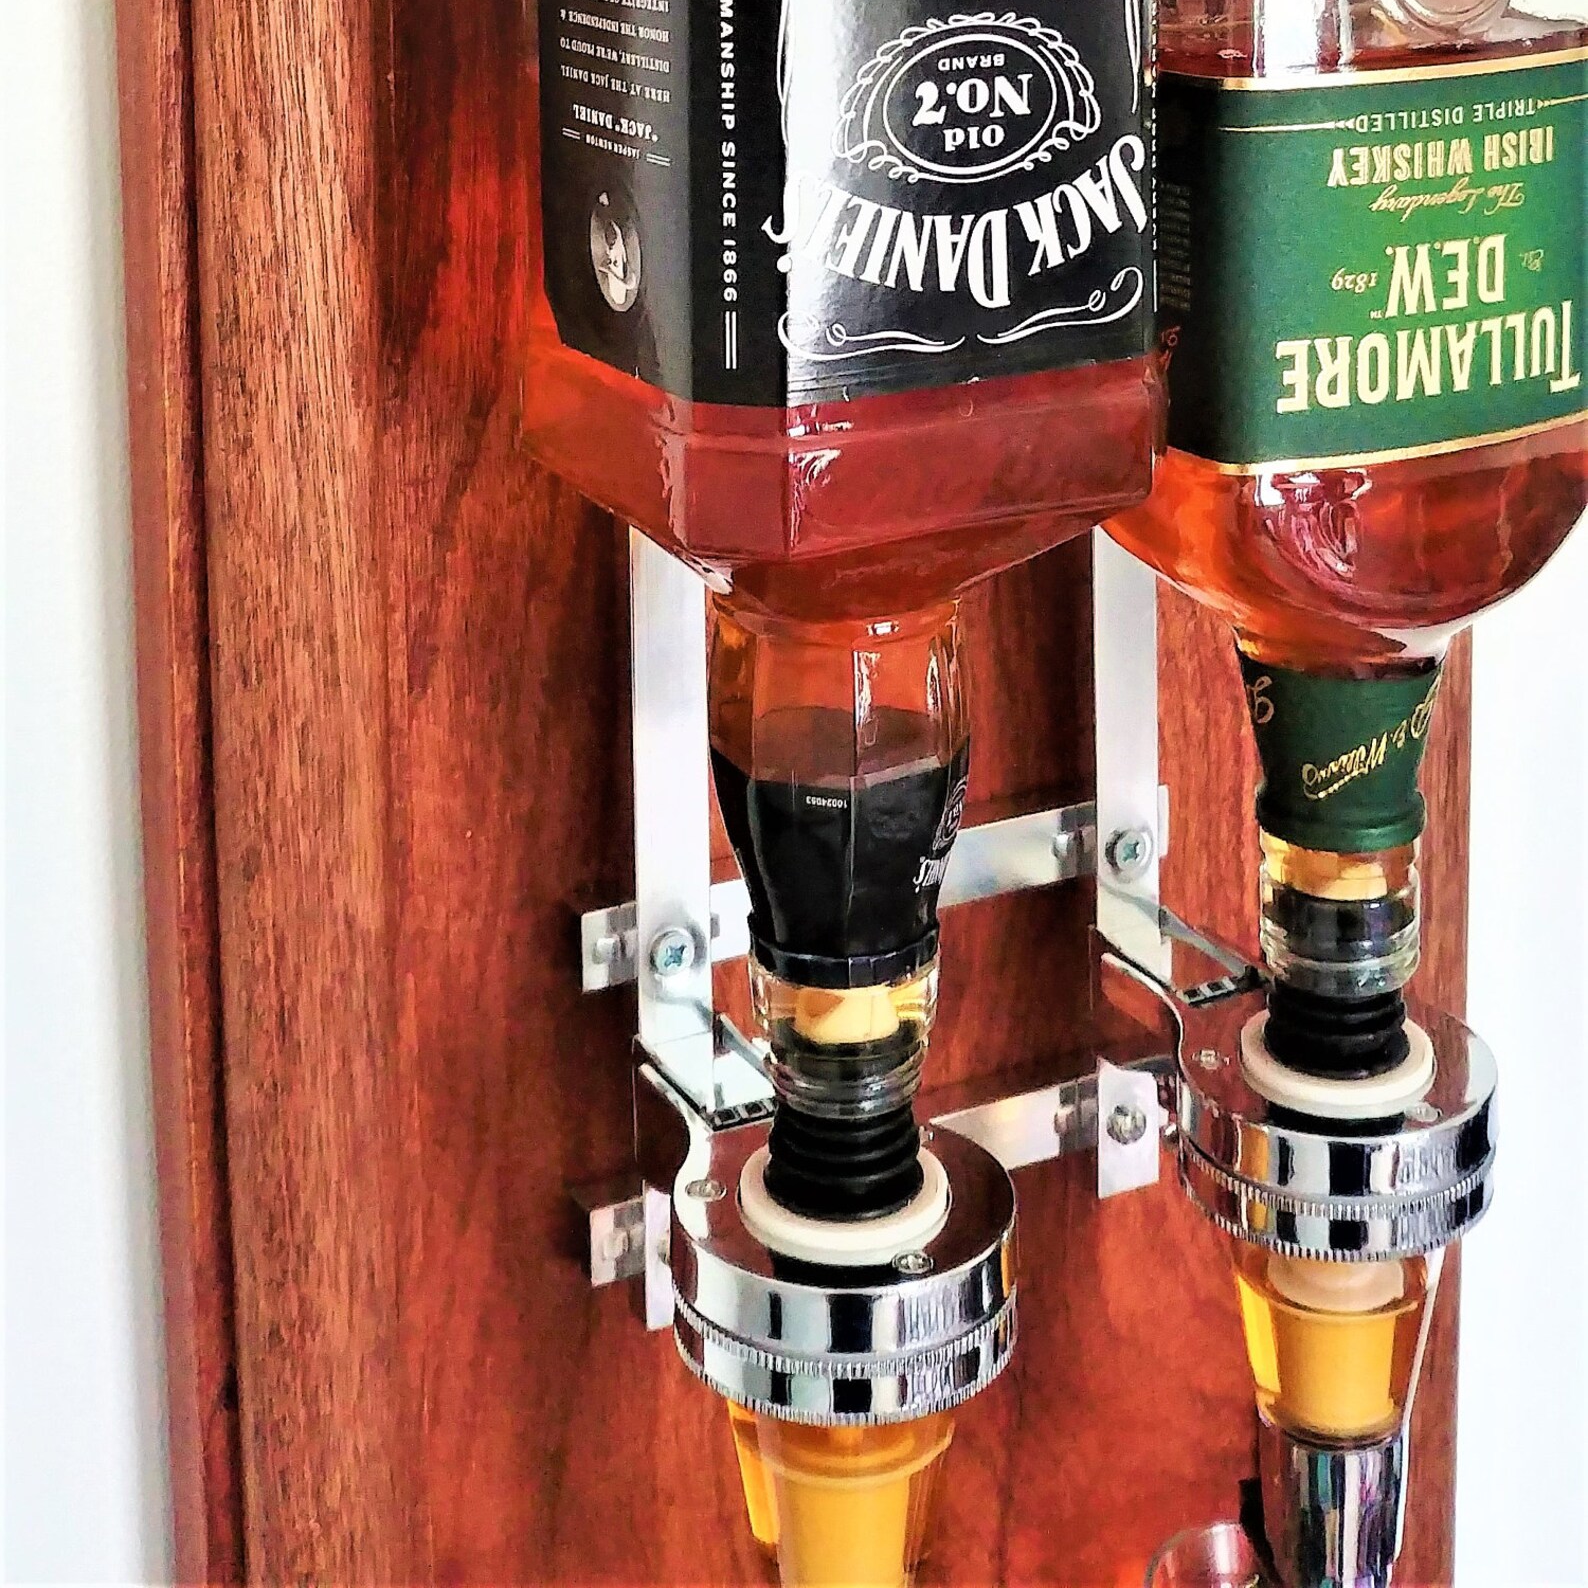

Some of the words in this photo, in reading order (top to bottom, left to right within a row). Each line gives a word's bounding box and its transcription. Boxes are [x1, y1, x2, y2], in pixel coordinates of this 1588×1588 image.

[559, 36, 571, 50] TO
[620, 22, 637, 37] THE
[638, 25, 669, 43] HONOR
[560, 64, 589, 83] DANIEL
[937, 52, 1006, 72] BRAND
[590, 73, 609, 89] JACK
[610, 77, 628, 93] THE
[630, 83, 642, 96] AT
[644, 86, 670, 103] HERE
[572, 103, 613, 130] DANIEL
[1355, 106, 1464, 134] DISTILLED
[1472, 98, 1535, 123] TRIPLE
[941, 124, 1006, 152] Old
[1483, 126, 1554, 171] IRISH
[1326, 137, 1473, 188] WHISKEY
[720, 140, 737, 228] SINCE
[1012, 134, 1148, 276] JACK
[1368, 175, 1485, 223] Legendary
[1484, 181, 1525, 216] The
[722, 238, 738, 303] 1866
[1330, 267, 1378, 294] 1829
[1383, 232, 1508, 320] D.E.W.
[1275, 299, 1581, 415] TULLAMORE
